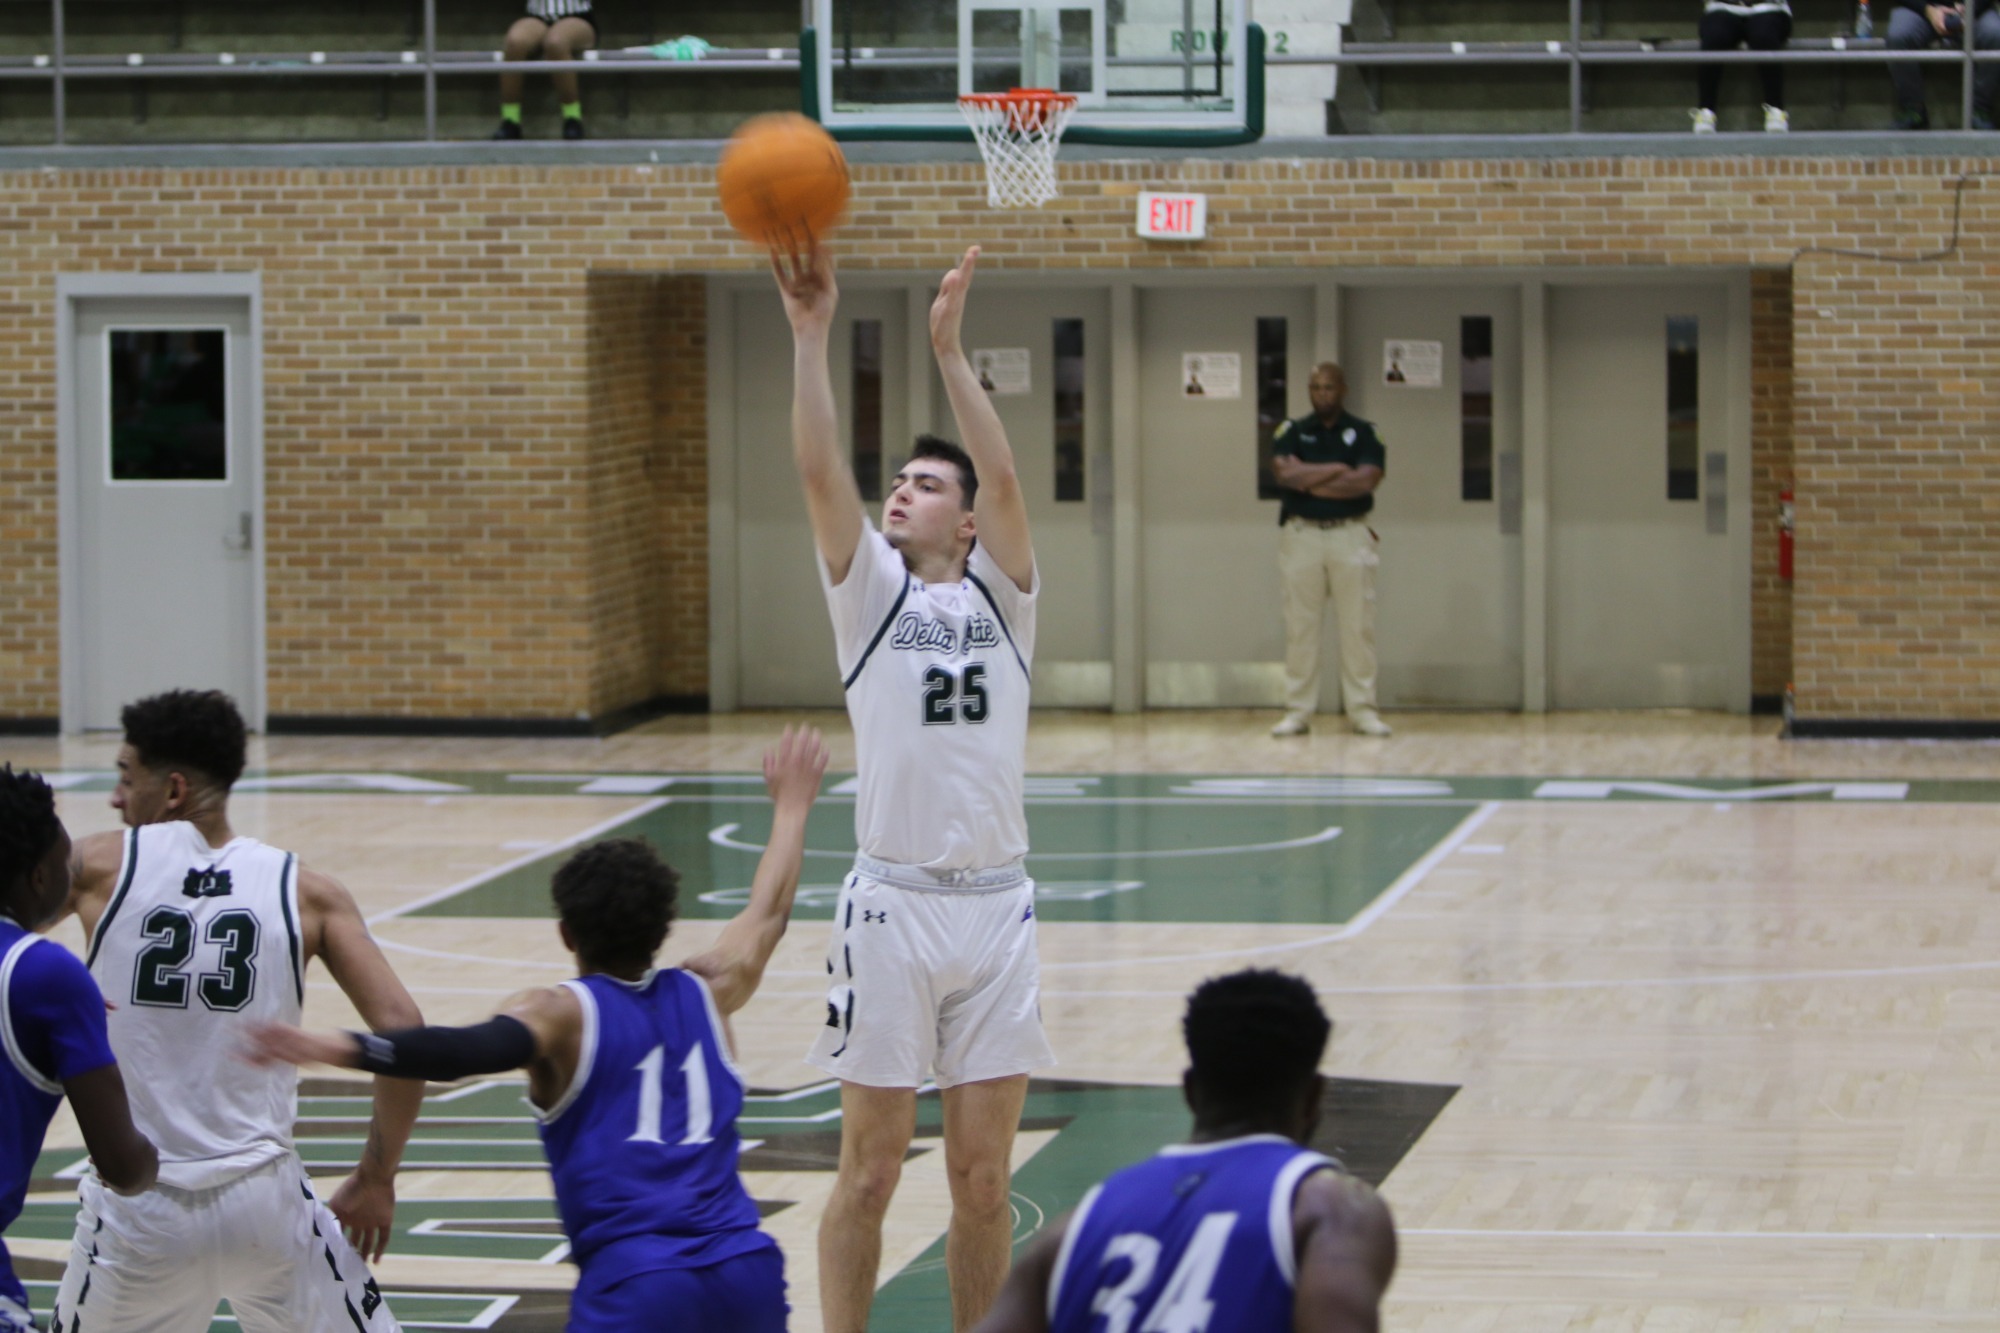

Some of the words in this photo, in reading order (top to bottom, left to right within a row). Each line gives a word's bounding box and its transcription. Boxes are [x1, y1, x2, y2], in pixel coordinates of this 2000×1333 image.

[1149, 198, 1195, 233] EXIT
[891, 611, 957, 655] Delta
[922, 662, 989, 726] 25
[131, 904, 261, 1013] 23
[624, 1040, 715, 1146] 11
[1091, 1211, 1239, 1333] 34
